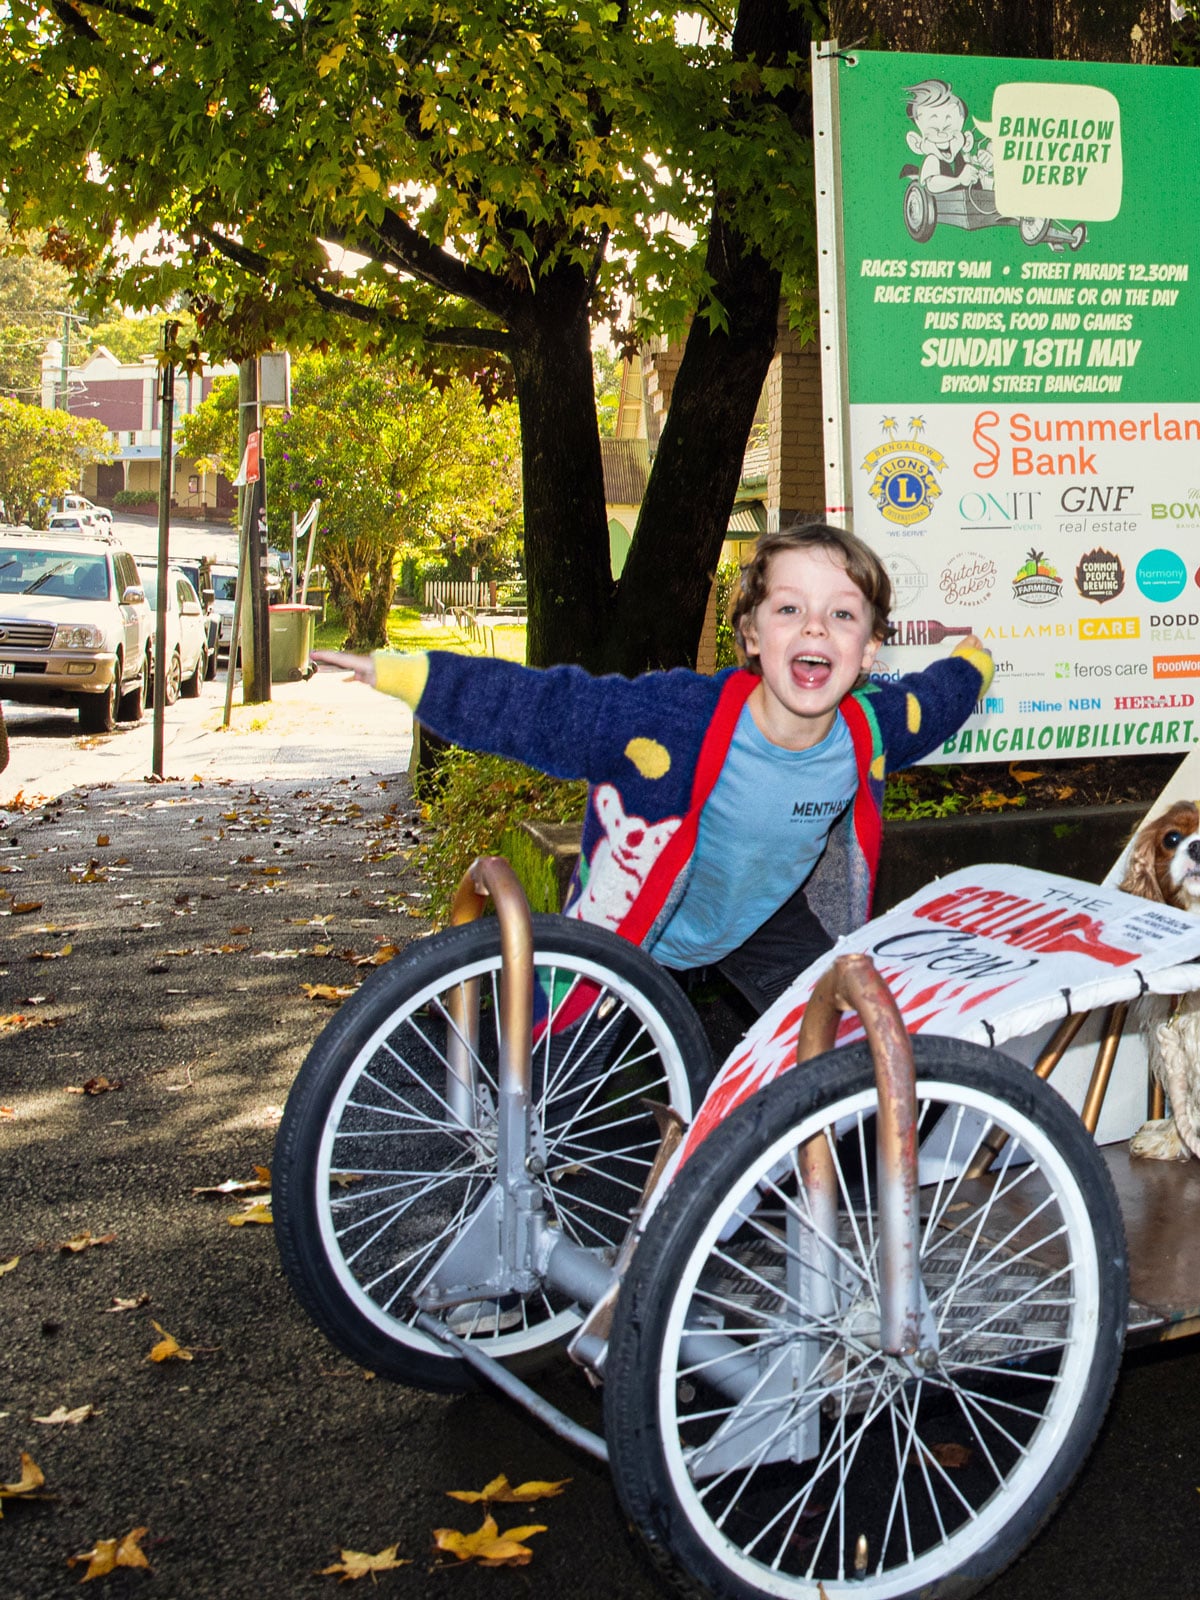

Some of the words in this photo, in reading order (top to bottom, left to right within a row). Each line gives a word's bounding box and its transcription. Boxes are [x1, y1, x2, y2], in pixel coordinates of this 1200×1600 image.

[999, 116, 1114, 140] BANGALOW
[1003, 140, 1111, 163] BILLYCART
[1022, 164, 1088, 186] DERBY
[860, 259, 908, 278] RACES
[910, 260, 955, 278] START
[957, 261, 992, 279] 9AM
[1021, 262, 1071, 280] STREET
[1072, 263, 1126, 281] PARADE
[1128, 264, 1188, 282] 12.30PM
[874, 285, 912, 304] RACE
[914, 286, 1024, 304] REGISTRATIONS
[1026, 287, 1075, 305] ONLINE
[1077, 288, 1098, 305] OR
[1100, 288, 1122, 306] ON
[1125, 288, 1150, 306] THE
[1151, 289, 1179, 306] DAY
[924, 312, 960, 330] PLUS
[961, 312, 1006, 333] RIDES,
[1009, 312, 1049, 331] FOOD
[1051, 313, 1081, 331] AND
[1083, 313, 1133, 332] GAMES
[920, 337, 1018, 368] SUNDAY
[1022, 337, 1084, 368] 18TH
[1086, 338, 1142, 368] MAY
[940, 374, 990, 393] BYRON
[992, 374, 1043, 393] STREET
[1044, 375, 1122, 394] BANGALOW
[874, 442, 934, 457] BANGALOW
[884, 459, 925, 474] LIONS
[1012, 446, 1099, 475] Bank
[898, 478, 916, 502] L
[1061, 486, 1134, 513] GNF
[959, 491, 1042, 522] ONIT
[1059, 519, 1088, 533] real
[1092, 520, 1137, 532] estate
[939, 560, 997, 591] Butcher
[1083, 562, 1118, 572] COMMON
[1086, 572, 1115, 581] PEOPLE
[1139, 569, 1184, 579] harmony
[904, 576, 926, 586] HOTEL
[945, 577, 996, 605] Baker
[1018, 583, 1058, 595] FARMERS
[1083, 581, 1118, 591] BREWING
[983, 624, 1073, 639] ALLAMBI
[1082, 620, 1135, 637] CARE
[1150, 628, 1196, 641] REAL
[1074, 662, 1112, 678] feros
[1115, 662, 1148, 676] care
[986, 697, 1004, 714] PRO
[1031, 700, 1062, 713] Nine
[1069, 698, 1102, 711] NBN
[1113, 694, 1195, 711] HERALD
[1042, 887, 1113, 912] THE
[872, 929, 1040, 980] Crew
